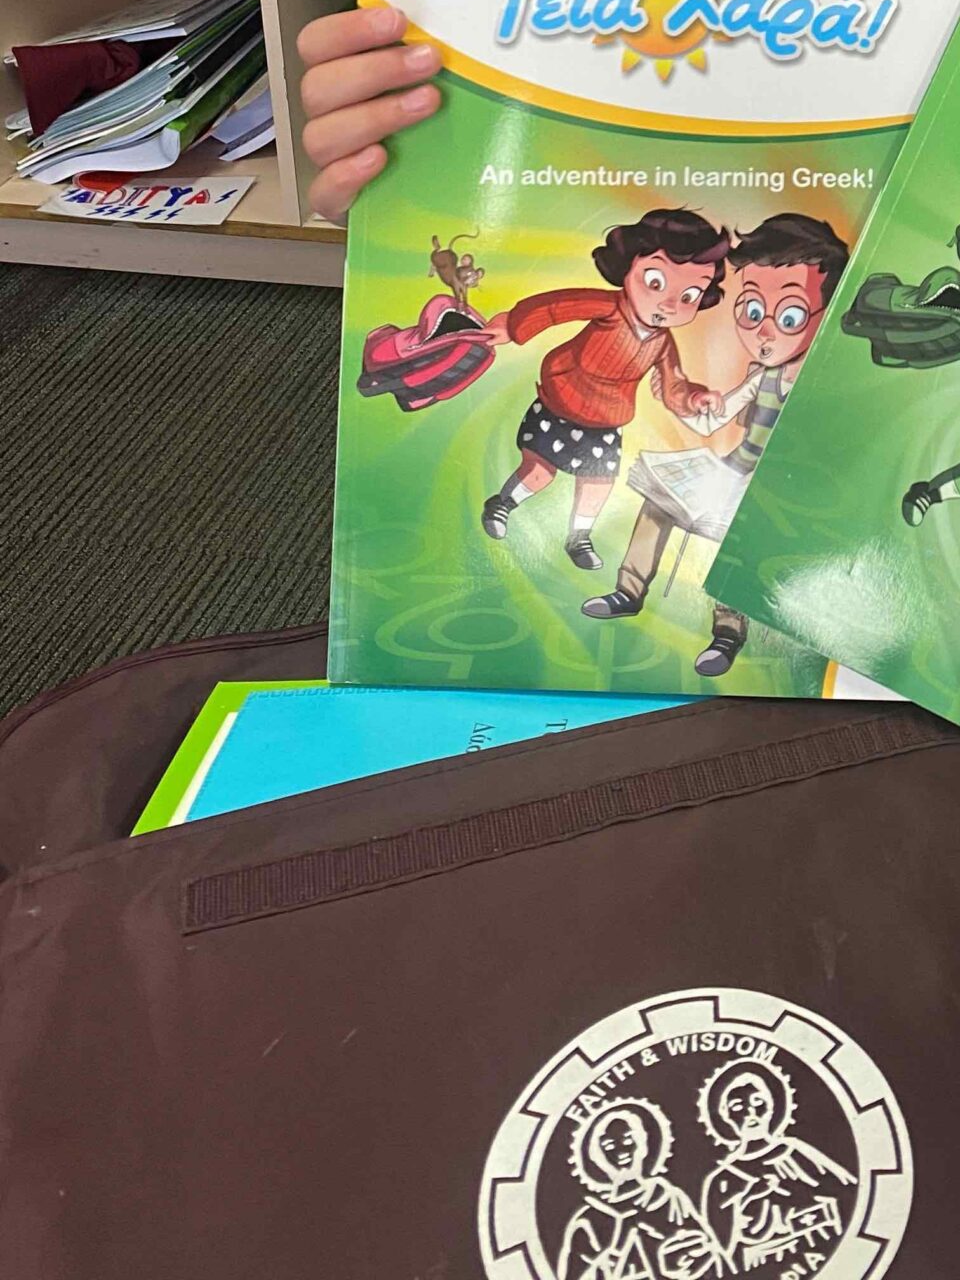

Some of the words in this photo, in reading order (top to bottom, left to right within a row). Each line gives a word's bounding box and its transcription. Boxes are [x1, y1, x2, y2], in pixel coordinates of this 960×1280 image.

[480, 166, 515, 186] An
[521, 166, 648, 188] adventure
[654, 166, 675, 187] in
[683, 166, 786, 192] learning
[792, 166, 875, 189] Greek!
[64, 185, 212, 208] ADITYA
[565, 1060, 636, 1124] FAITH
[640, 1048, 661, 1068] &
[665, 1032, 780, 1064] WISDOM
